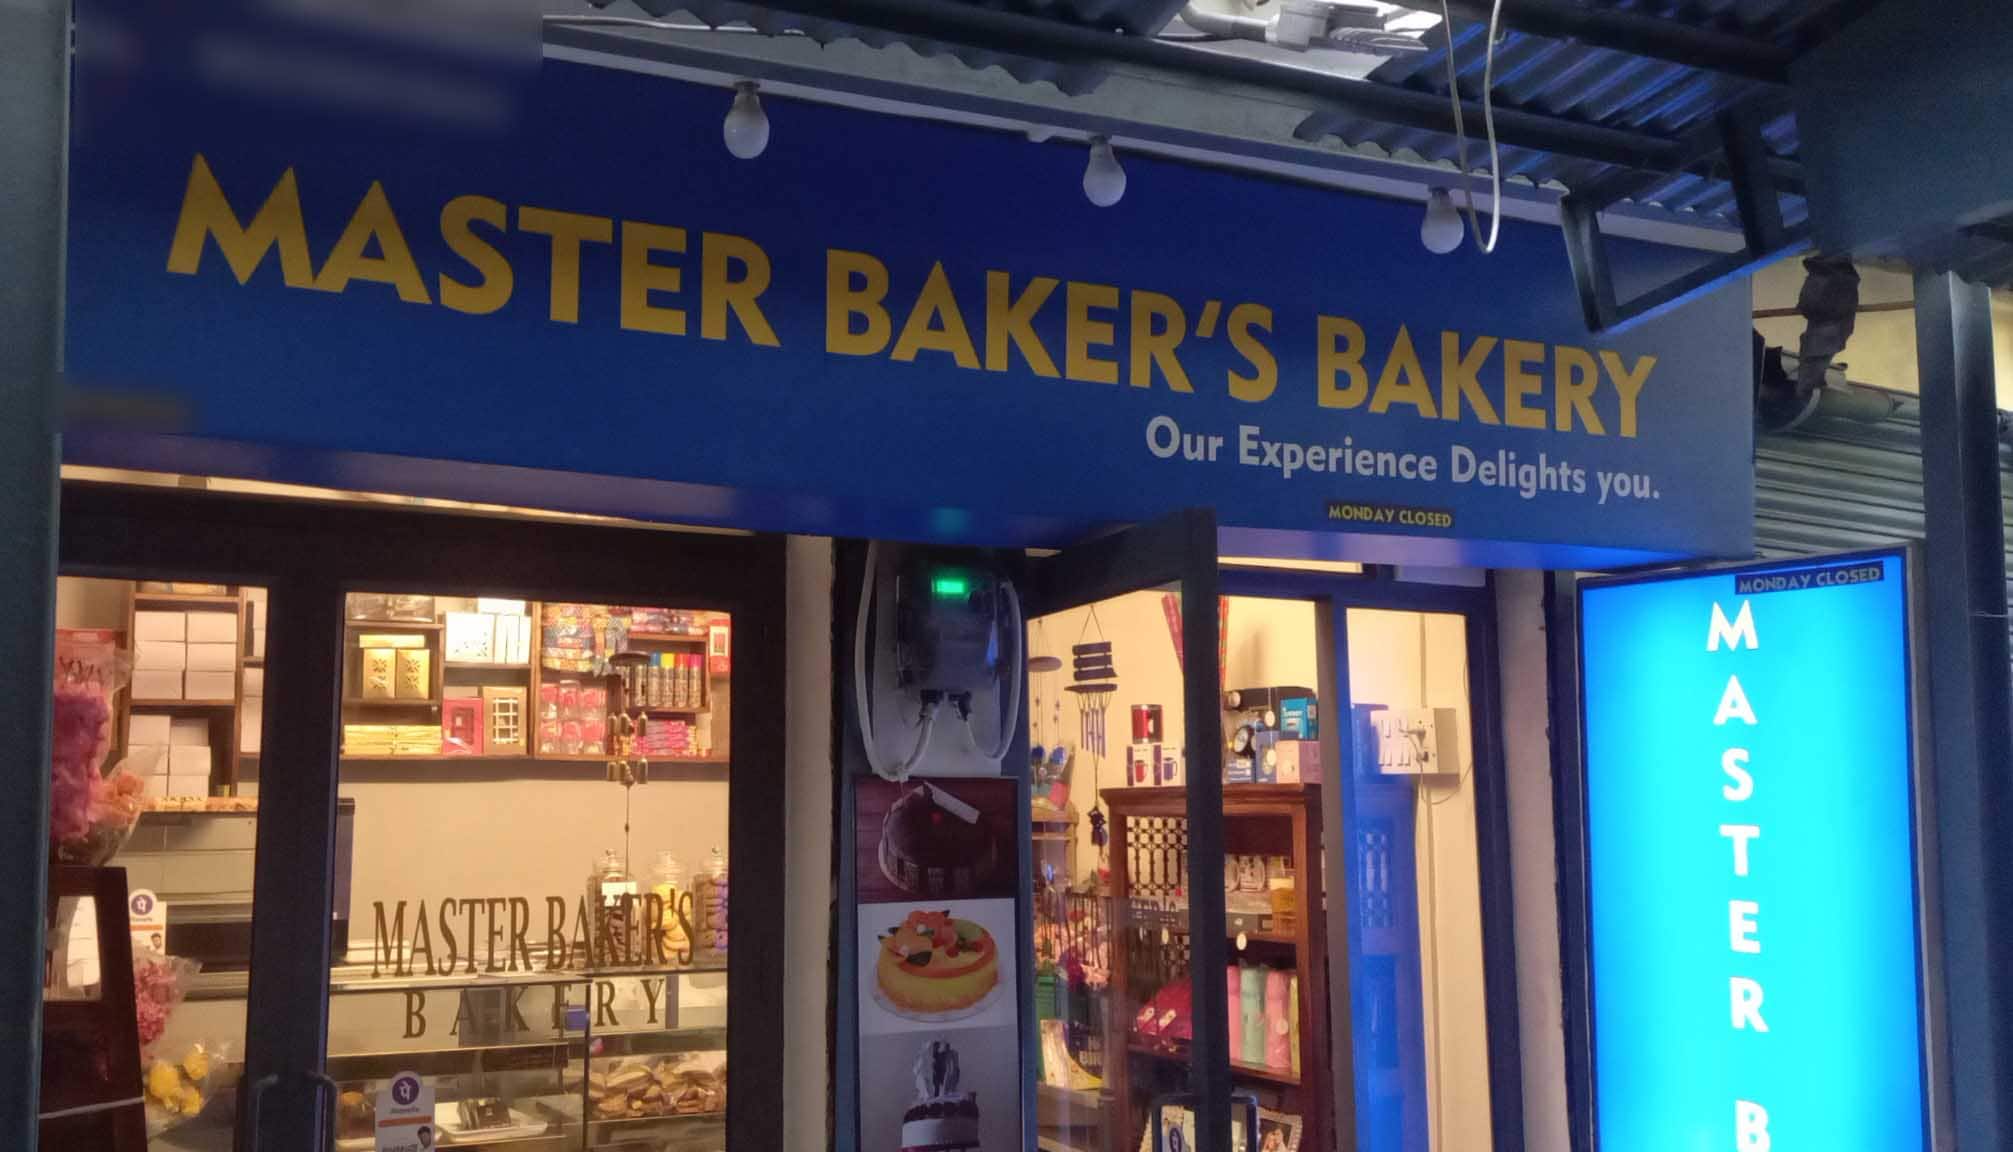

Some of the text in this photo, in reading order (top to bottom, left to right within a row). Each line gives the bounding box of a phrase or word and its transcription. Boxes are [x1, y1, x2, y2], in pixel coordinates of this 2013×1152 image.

[166, 152, 1658, 438] MASTER BAKER'S BAKERY
[1146, 415, 1661, 505] Our Experience Delights you.
[1328, 505, 1452, 528] MONDAY CLOSED
[1739, 567, 1881, 593] MONDAY CLOSED
[1705, 600, 1769, 1032] MASTER
[373, 888, 695, 978] MASTER BAKER'S
